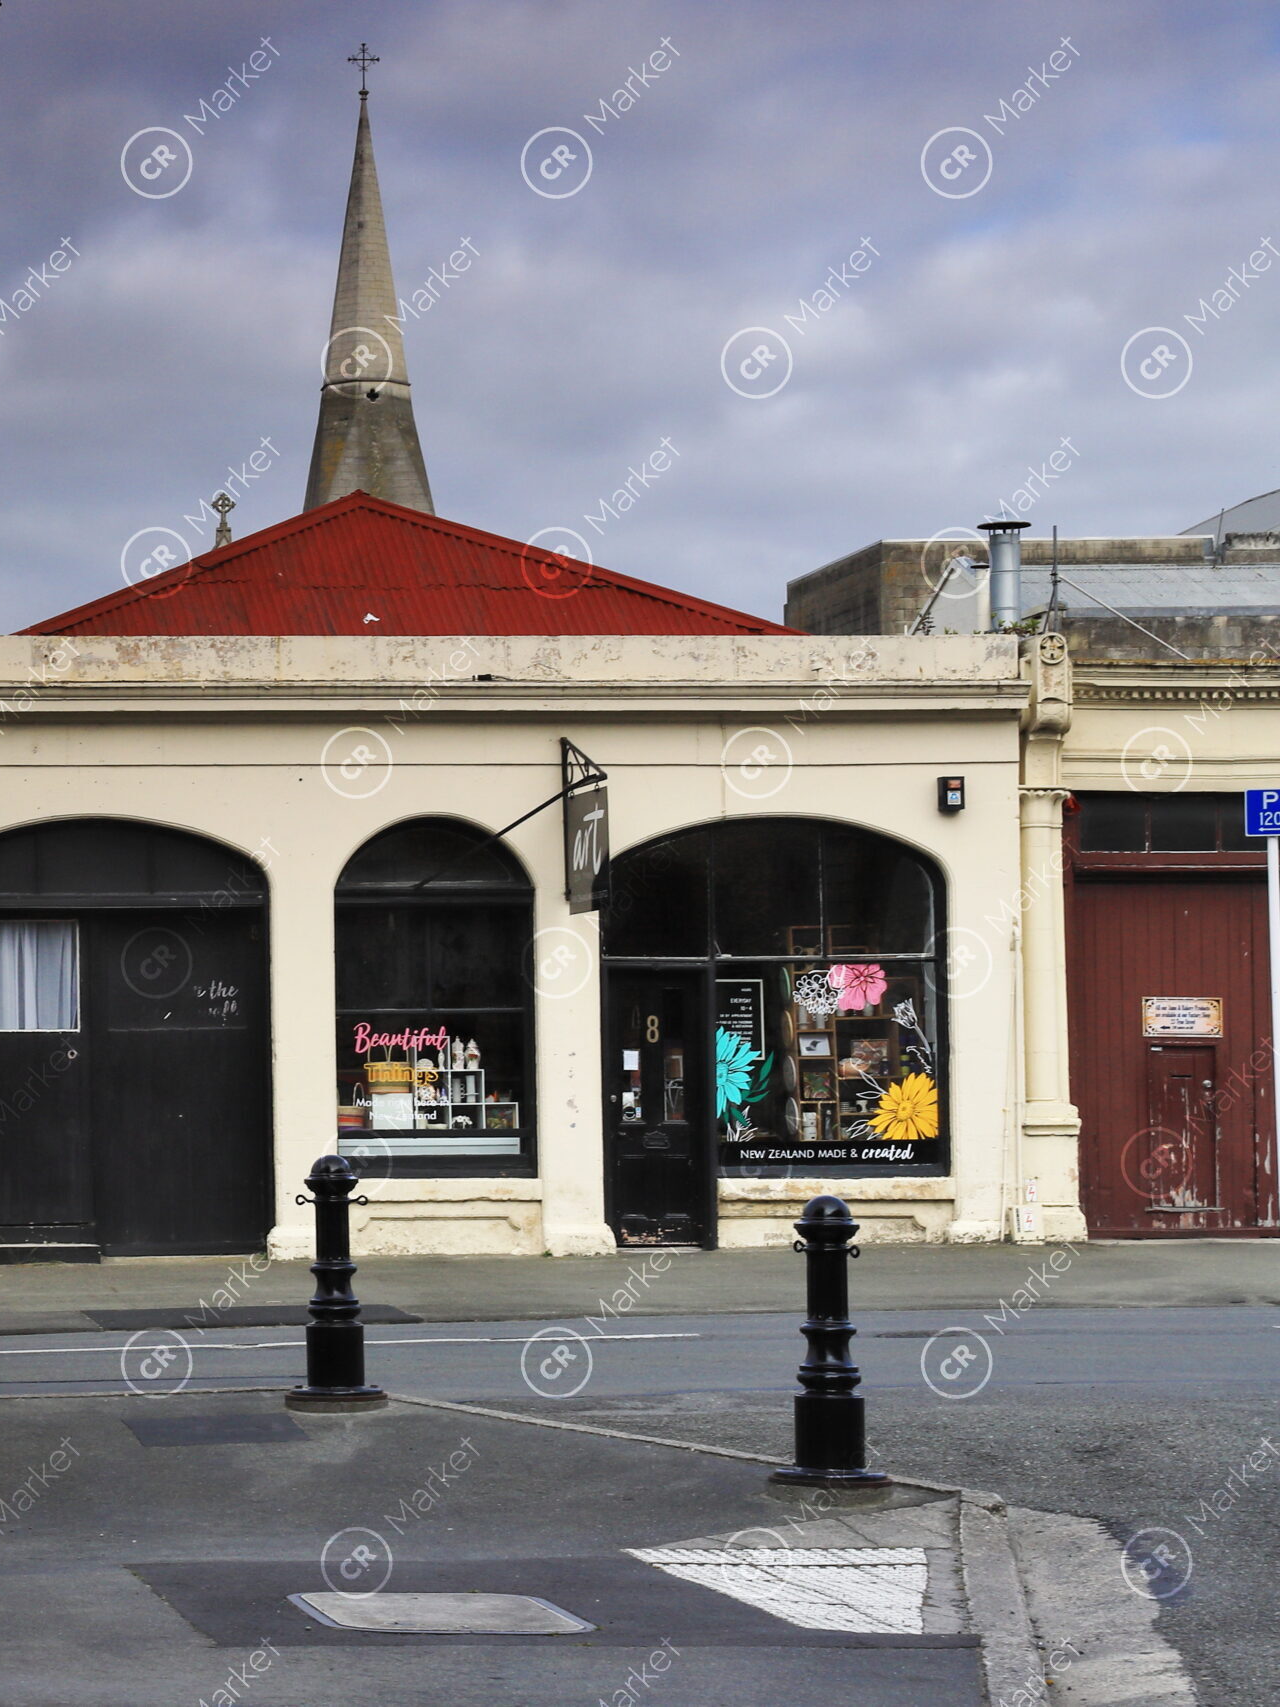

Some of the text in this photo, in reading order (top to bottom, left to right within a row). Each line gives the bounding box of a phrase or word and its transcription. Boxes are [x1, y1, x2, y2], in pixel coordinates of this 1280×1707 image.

[1263, 791, 1279, 809] P
[1259, 811, 1280, 826] 120
[573, 802, 605, 875] art
[209, 980, 239, 999] the
[353, 1022, 448, 1054] Beautiful
[646, 1015, 659, 1043] 8
[363, 1062, 439, 1087] Things
[740, 1143, 915, 1161] NEW ZEALAND MADE & created
